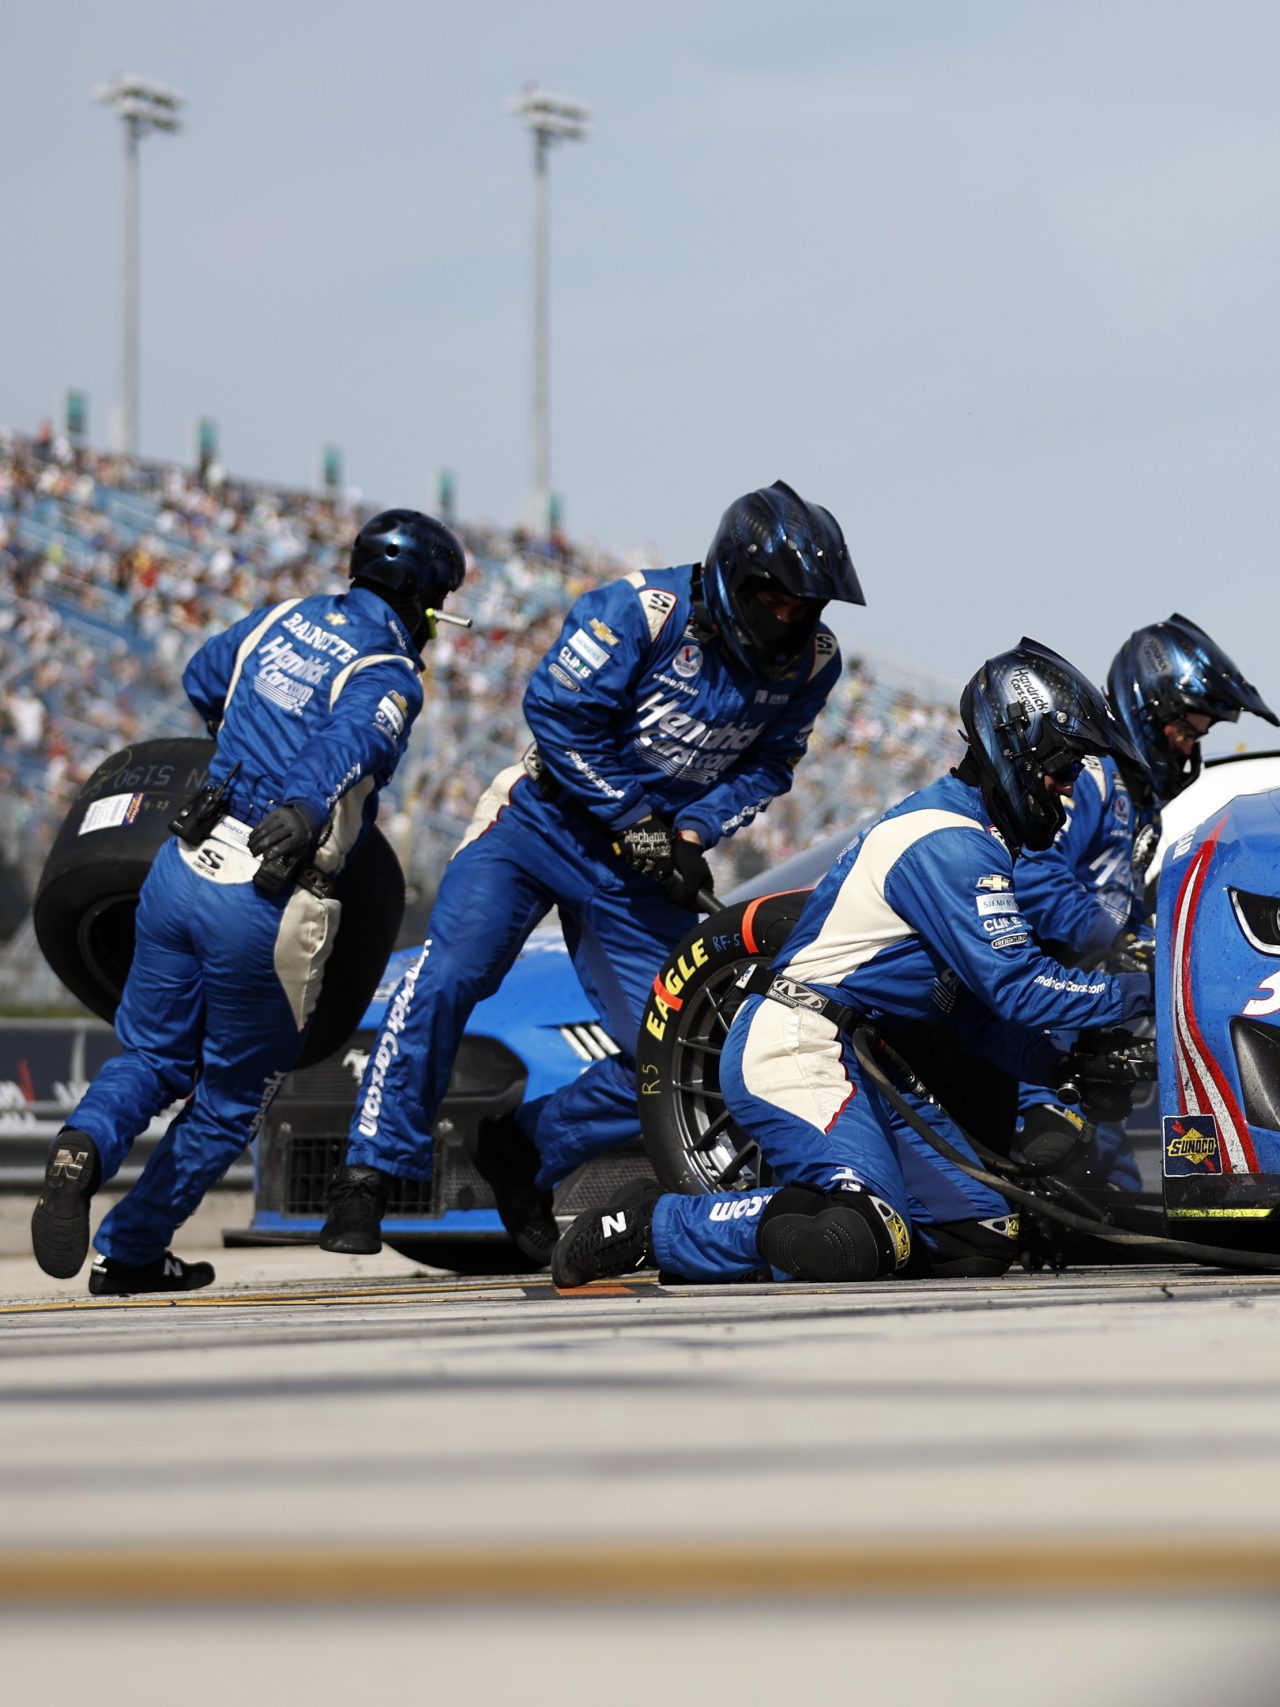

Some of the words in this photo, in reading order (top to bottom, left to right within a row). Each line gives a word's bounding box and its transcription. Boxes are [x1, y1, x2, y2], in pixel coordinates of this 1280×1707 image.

[1010, 678, 1036, 713] Cars.com
[1013, 667, 1049, 712] Hendrick
[624, 828, 668, 845] Mechanix
[646, 938, 709, 1041] EAGLE
[1170, 1139, 1215, 1155] SUNOCO
[602, 1211, 627, 1238] N
[164, 1258, 183, 1277] N
